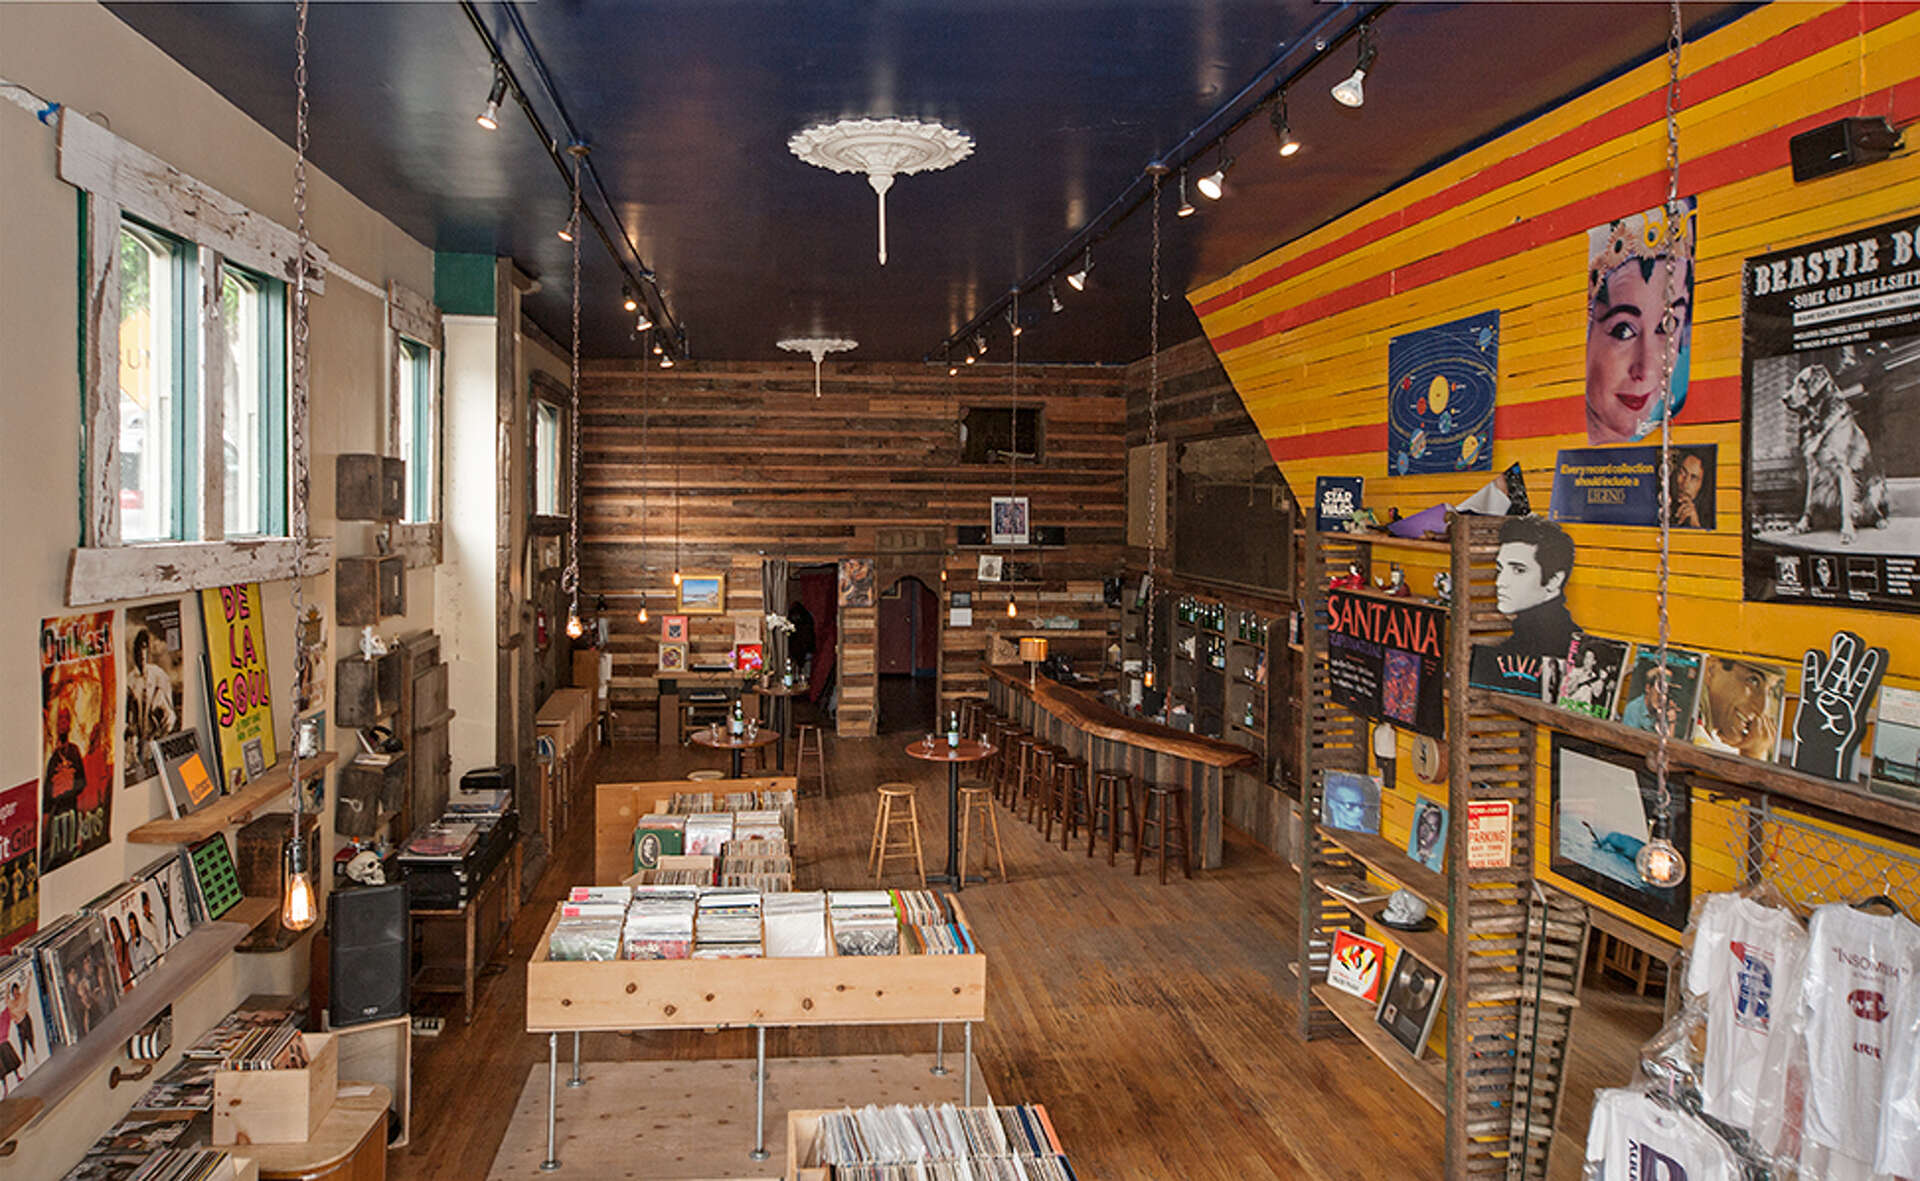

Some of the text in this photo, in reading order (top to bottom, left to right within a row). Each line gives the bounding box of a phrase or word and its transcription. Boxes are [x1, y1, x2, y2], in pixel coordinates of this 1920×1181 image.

[1753, 238, 1879, 296] BEASTIE
[1827, 283, 1853, 303] OLD
[1560, 464, 1584, 479] Every
[1613, 462, 1656, 474] collection
[1321, 502, 1354, 516] WARS
[1323, 490, 1352, 504] STAR
[220, 583, 249, 622] DE
[1328, 595, 1440, 658] SANTANA
[229, 624, 257, 668] LA
[217, 669, 269, 727] SOUL
[11, 822, 37, 852] Girl
